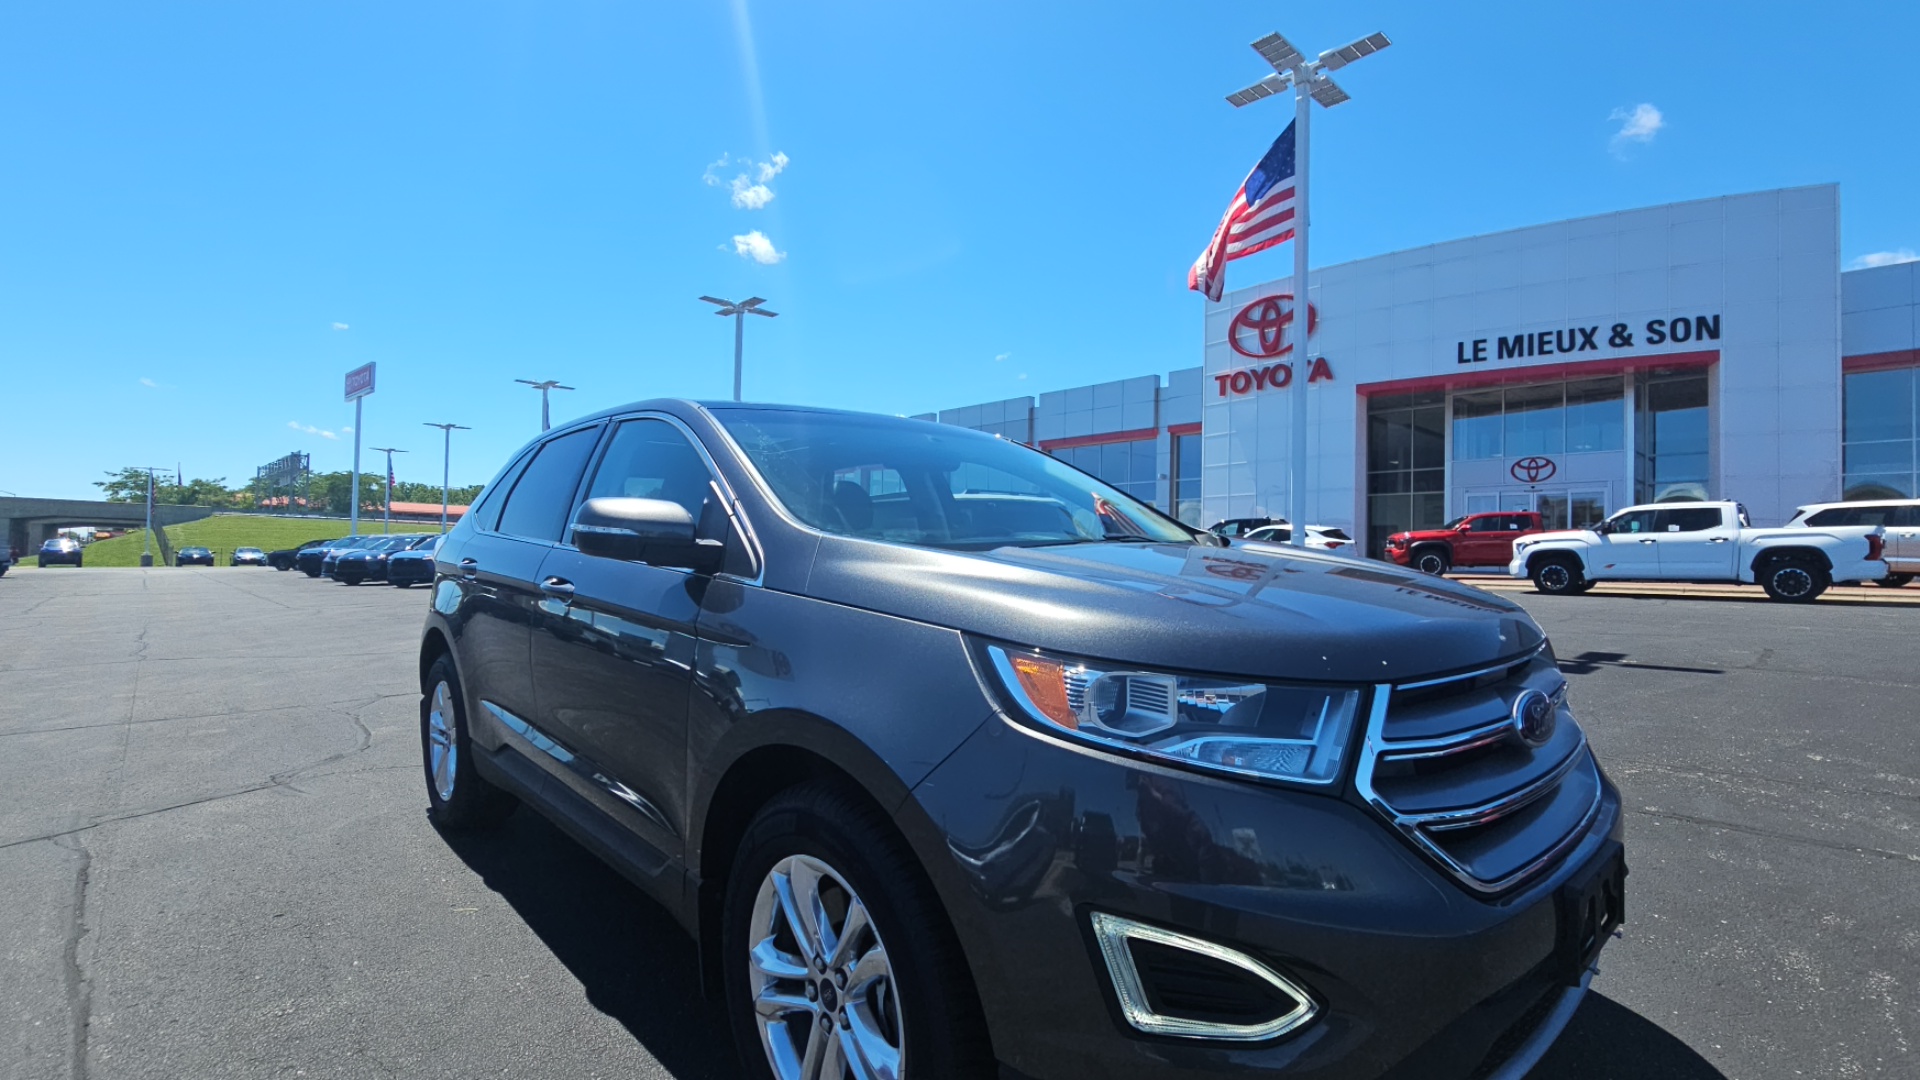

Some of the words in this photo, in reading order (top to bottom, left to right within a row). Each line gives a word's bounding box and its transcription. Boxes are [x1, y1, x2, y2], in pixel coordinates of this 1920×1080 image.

[1457, 338, 1488, 364] LE
[1497, 325, 1599, 360] MIEUX
[1608, 322, 1634, 348] &
[1646, 314, 1721, 345] SON
[1214, 357, 1334, 397] TOYOA
